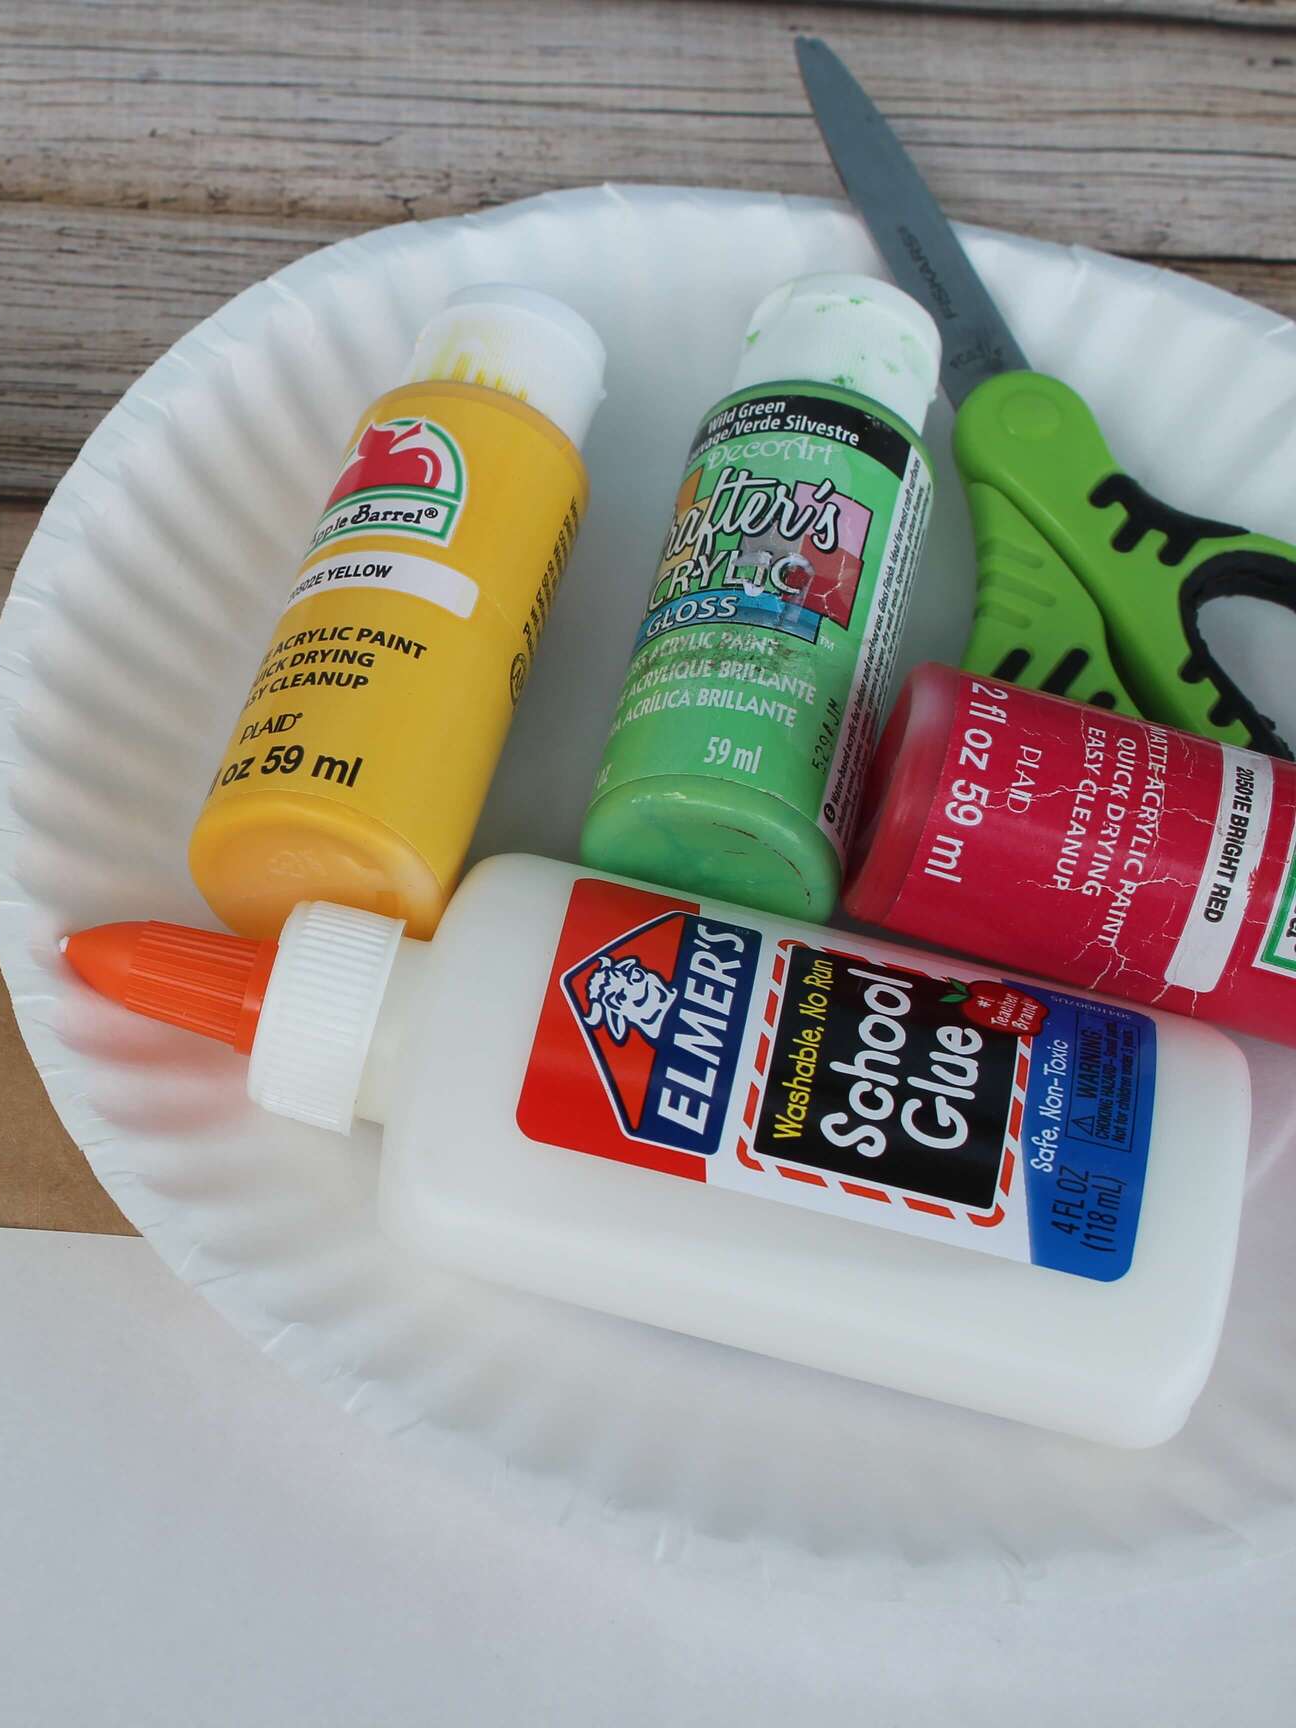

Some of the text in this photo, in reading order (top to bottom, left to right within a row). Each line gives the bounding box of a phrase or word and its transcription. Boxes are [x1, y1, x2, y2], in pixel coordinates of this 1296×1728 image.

[708, 401, 786, 434] Wild Green
[783, 415, 860, 446] Silvestre
[707, 436, 833, 470] DecoArt
[665, 466, 840, 562] rafter's
[326, 563, 392, 582] YELLOW
[648, 550, 815, 612] CRYLIC
[273, 626, 354, 657] ACRYLIC
[356, 627, 428, 659] PAINT
[646, 596, 738, 638] GLOSS
[254, 655, 290, 686] UICK
[289, 649, 376, 668] DRYING
[651, 631, 781, 661] ACRYLIC PAINT
[269, 671, 369, 693] CLEANUP
[624, 688, 691, 725] ACRÍLICA
[696, 688, 797, 728] BRILLANTE
[628, 659, 713, 699] ACRYLIQUE
[718, 660, 817, 704] BRILLANTE
[221, 756, 257, 786] oz
[260, 744, 304, 775] 59
[311, 754, 363, 788] ml
[704, 736, 763, 774] 59 ml
[1006, 745, 1042, 814] PLAID
[924, 682, 1008, 883] 2 fl oz 59 ml
[1052, 726, 1106, 891] EASY CLEANUP
[1081, 737, 1136, 897] QUICK DRYING
[1097, 726, 1168, 948] MATTE ACRYLIC PAINT
[1203, 765, 1255, 924] 20501E BRIGHT RED
[657, 923, 745, 1136] ELMER'S
[991, 992, 1019, 1027] Teacher
[1011, 1001, 1038, 1031] Brand
[772, 959, 834, 1140] Washable, No Run
[819, 967, 913, 1158] School
[900, 1025, 983, 1150] Glue
[1030, 1039, 1069, 1173] Safe, Non-Toxic
[1050, 1165, 1090, 1236] 4 FL OZ
[1079, 1174, 1128, 1253] (118 mL)
